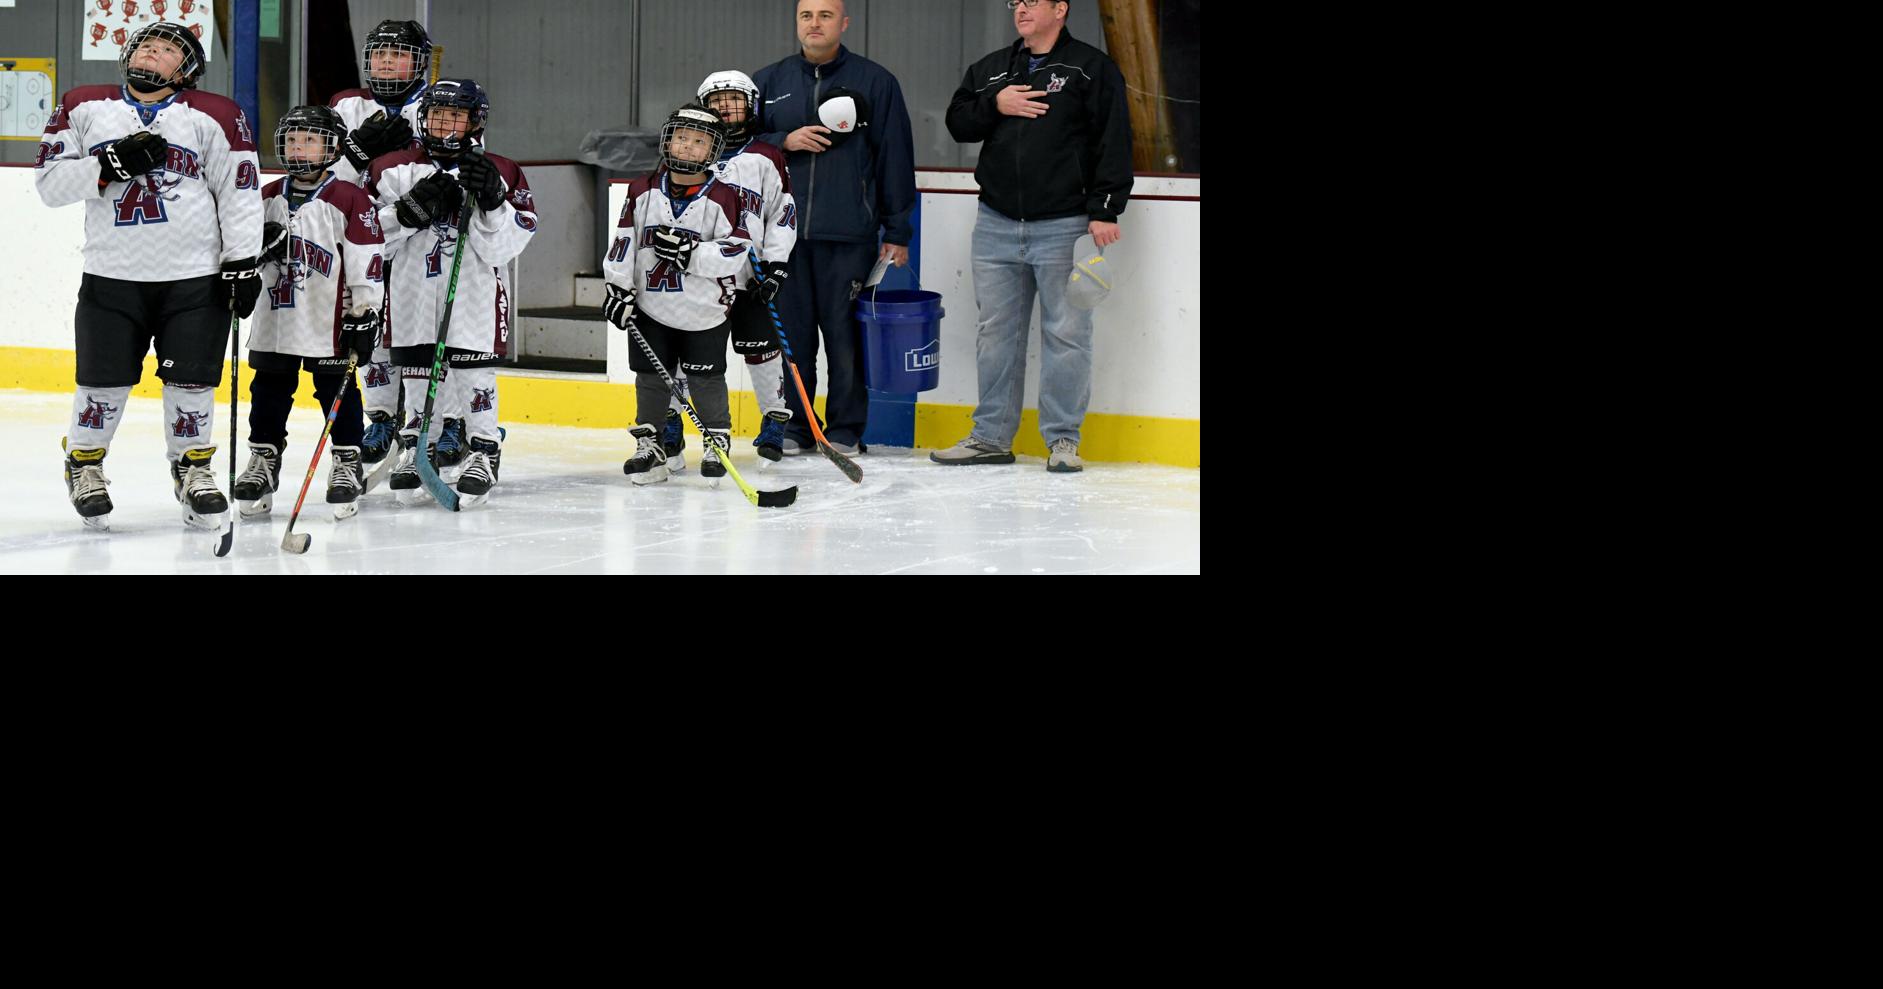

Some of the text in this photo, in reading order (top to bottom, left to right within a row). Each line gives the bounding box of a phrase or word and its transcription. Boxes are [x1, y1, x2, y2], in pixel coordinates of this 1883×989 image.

[235, 159, 259, 191] 91
[735, 340, 769, 348] CCM
[162, 359, 174, 368] B
[682, 362, 714, 372] CCM
[681, 403, 706, 434] ALPHA
